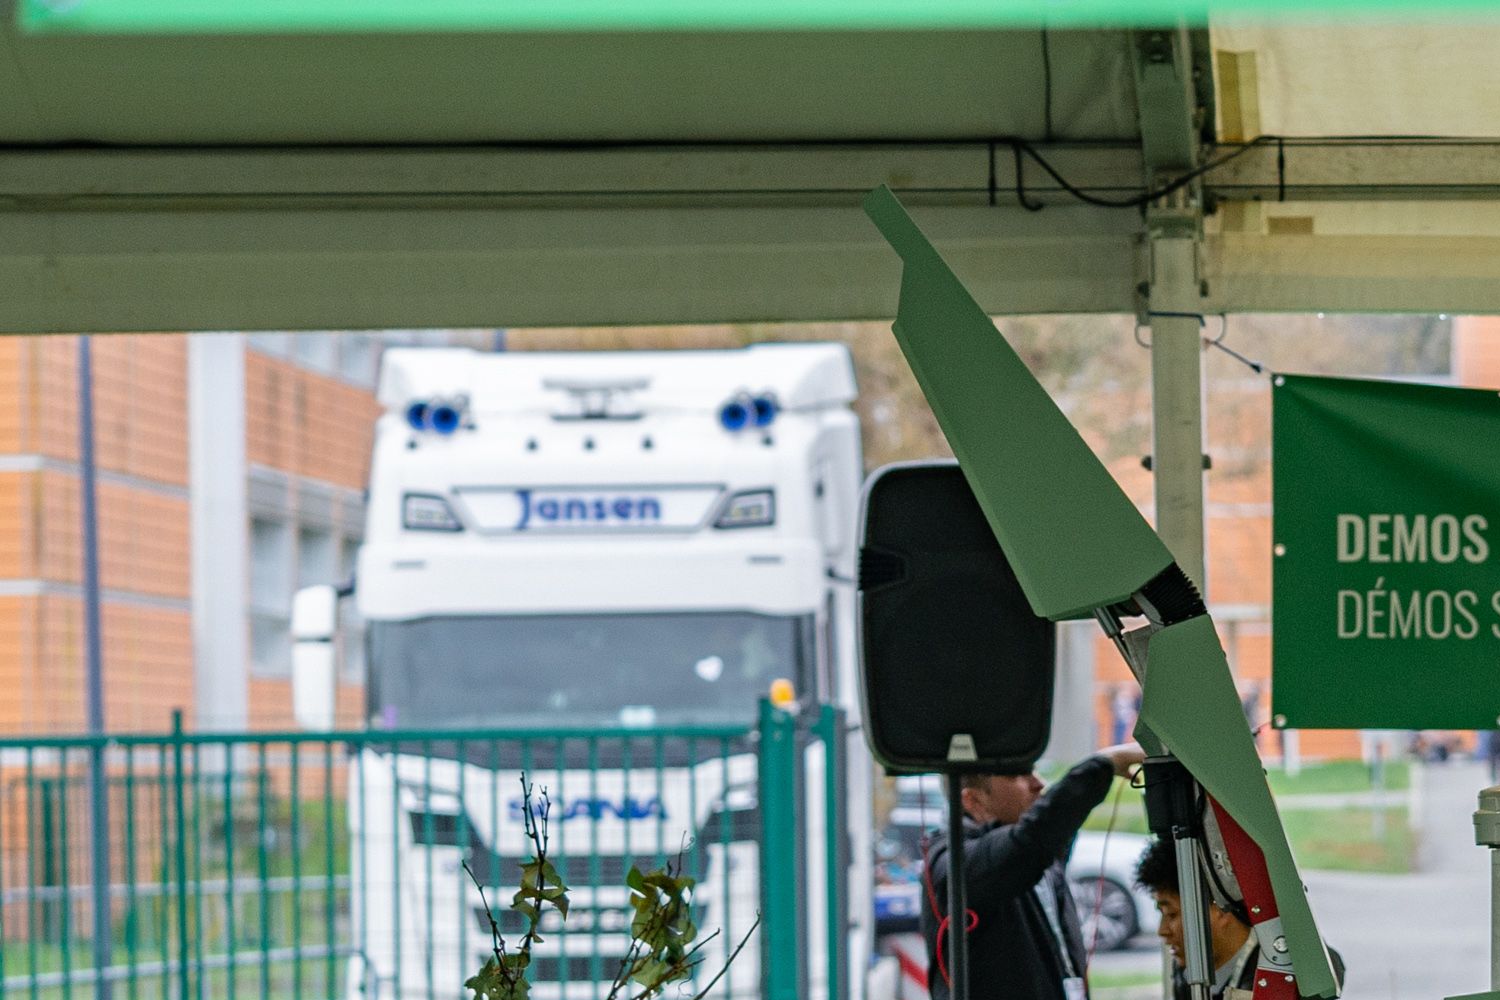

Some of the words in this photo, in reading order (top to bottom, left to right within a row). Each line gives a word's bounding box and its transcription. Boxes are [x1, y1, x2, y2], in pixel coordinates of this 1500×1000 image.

[514, 489, 661, 531] Jansen
[1337, 513, 1489, 563] DEMOS
[1337, 576, 1479, 640] DÉMOS
